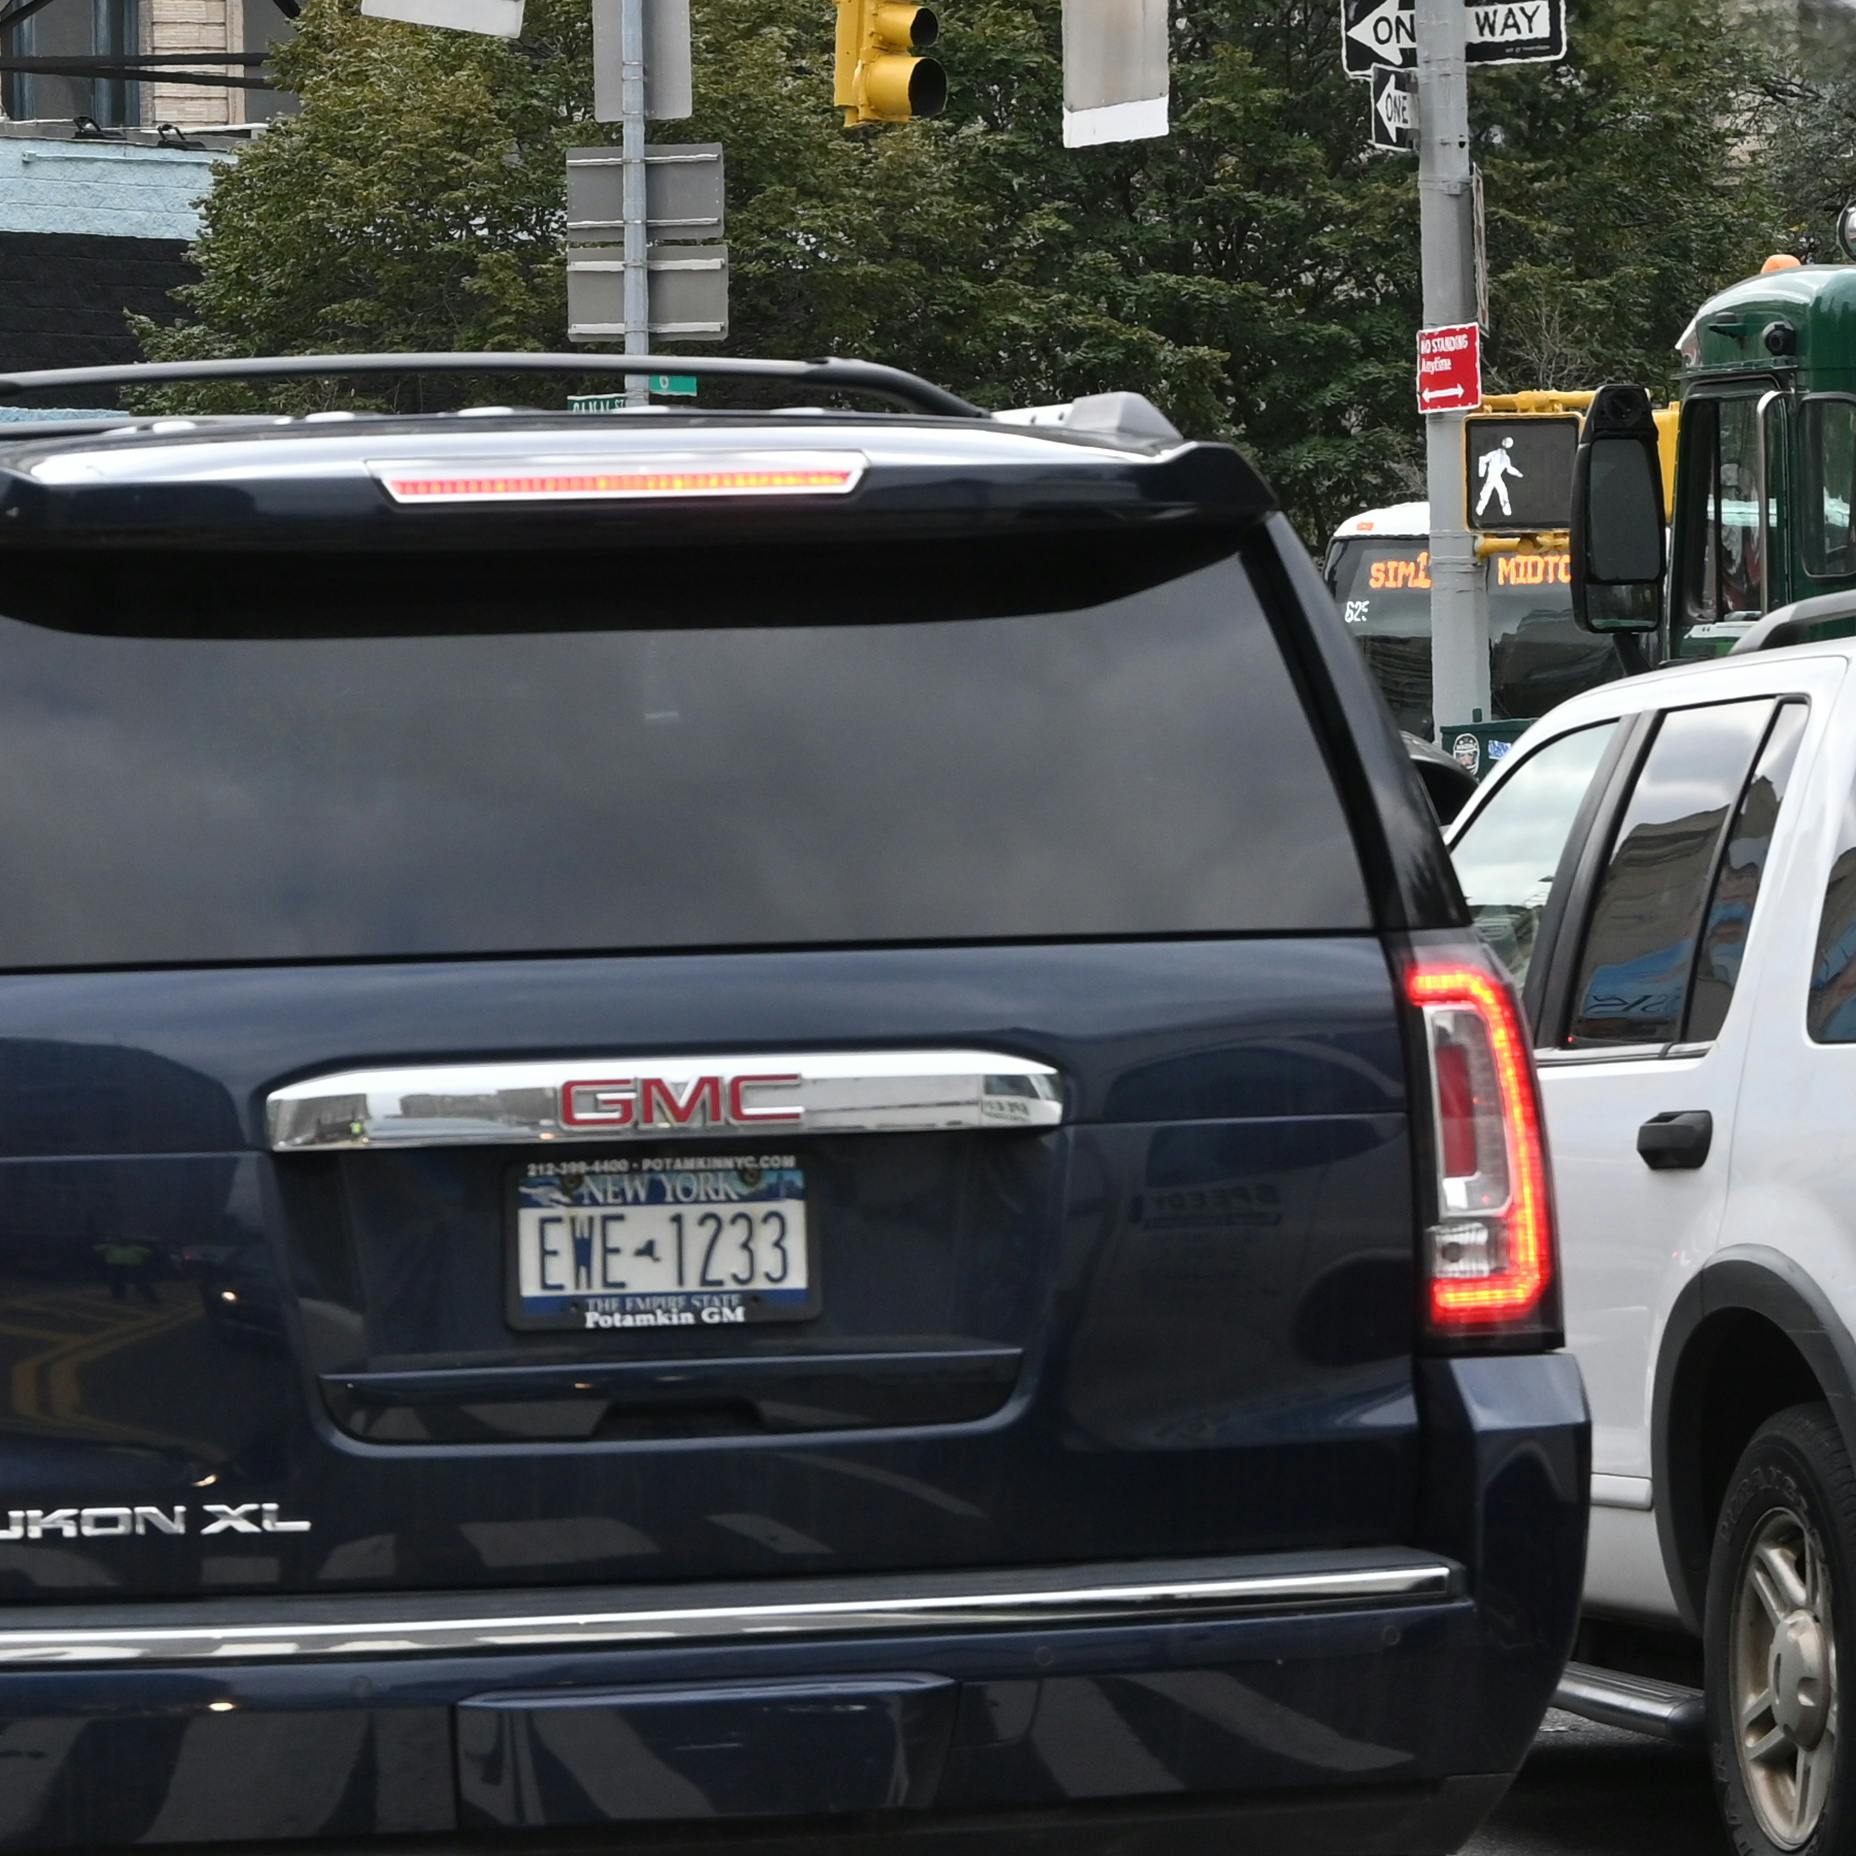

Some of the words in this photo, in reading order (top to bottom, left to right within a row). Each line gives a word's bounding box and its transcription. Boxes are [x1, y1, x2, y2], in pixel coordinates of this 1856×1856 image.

[1373, 14, 1416, 44] ON
[1475, 5, 1540, 37] WAY
[1386, 93, 1408, 124] ONE
[1498, 554, 1571, 585] MIDTO
[559, 1074, 803, 1129] GMC
[643, 1156, 796, 1171] POTAMKINNYC.COM
[581, 1174, 655, 1205] NEW
[663, 1171, 739, 1202] YORK
[539, 1214, 627, 1291] EWE
[670, 1211, 788, 1287] 1233
[585, 1311, 694, 1328] Potamkin
[701, 1307, 744, 1324] GM
[587, 1298, 623, 1312] THE
[626, 1296, 686, 1311] EMPIRE
[691, 1295, 741, 1309] STATE
[200, 1503, 311, 1535] XL
